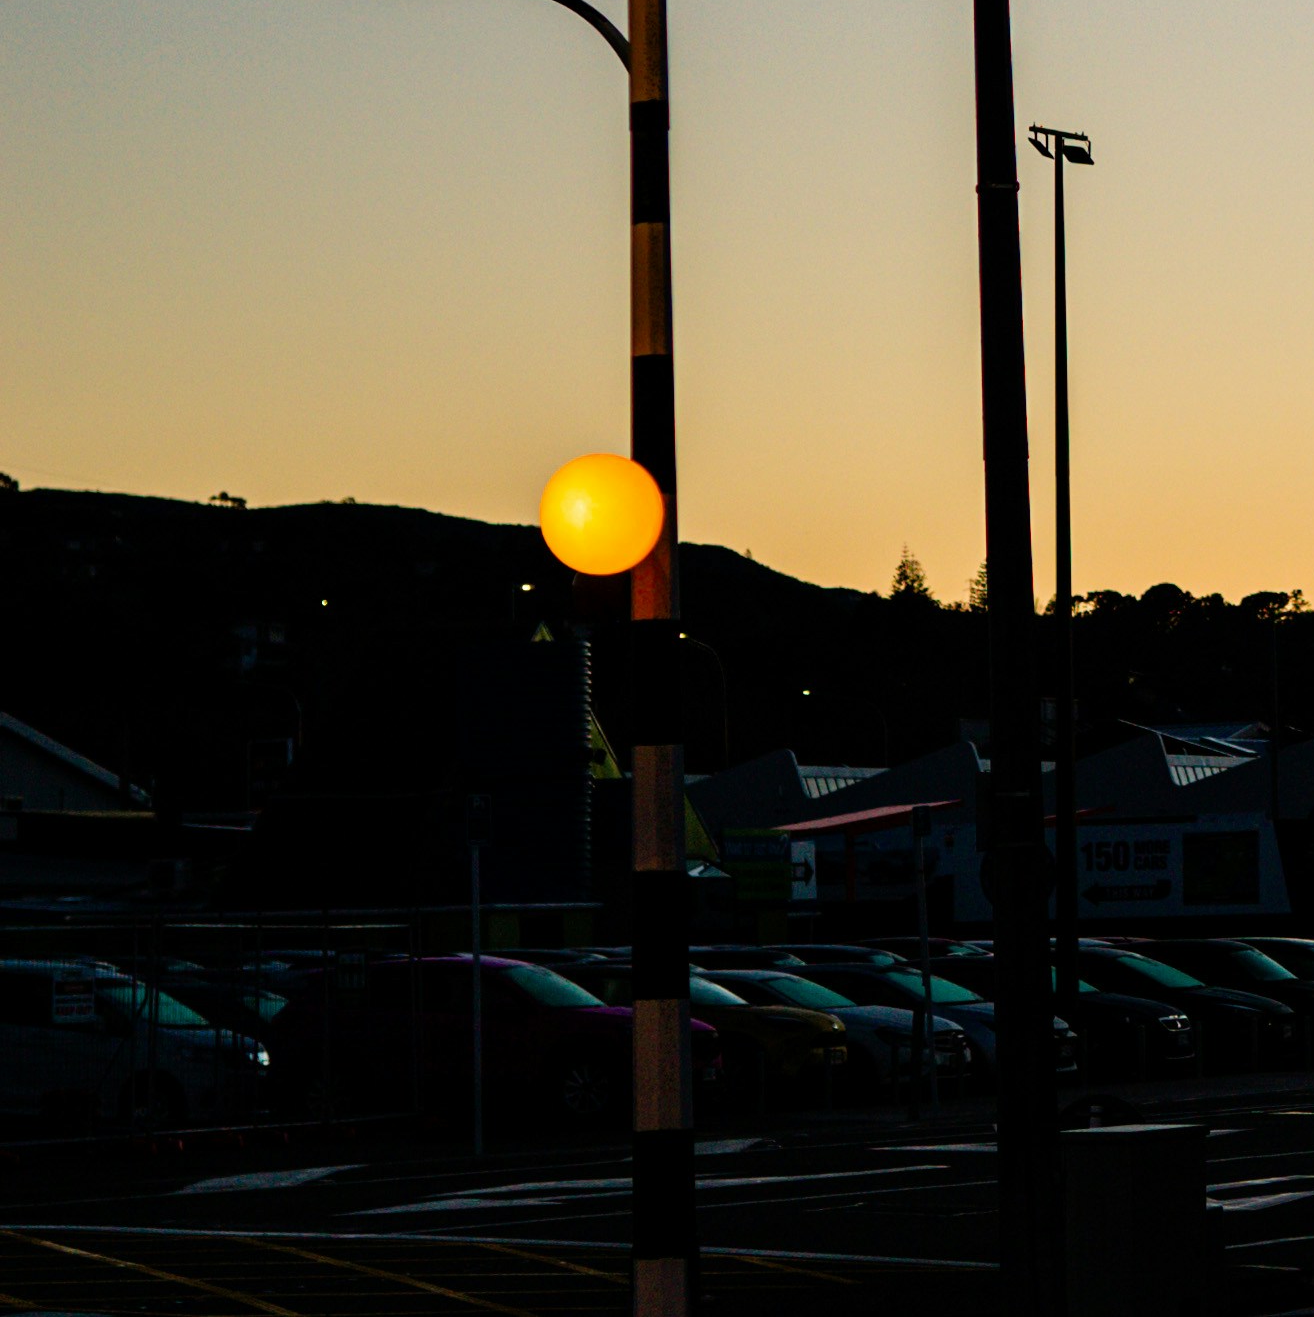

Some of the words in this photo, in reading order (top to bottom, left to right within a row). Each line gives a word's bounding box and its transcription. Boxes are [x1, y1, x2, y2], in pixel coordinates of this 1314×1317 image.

[1079, 840, 1130, 872] 150
[1133, 839, 1171, 854] MORE
[1133, 855, 1168, 870] CARS
[1104, 887, 1130, 899] THIS
[1132, 886, 1156, 898] WAY
